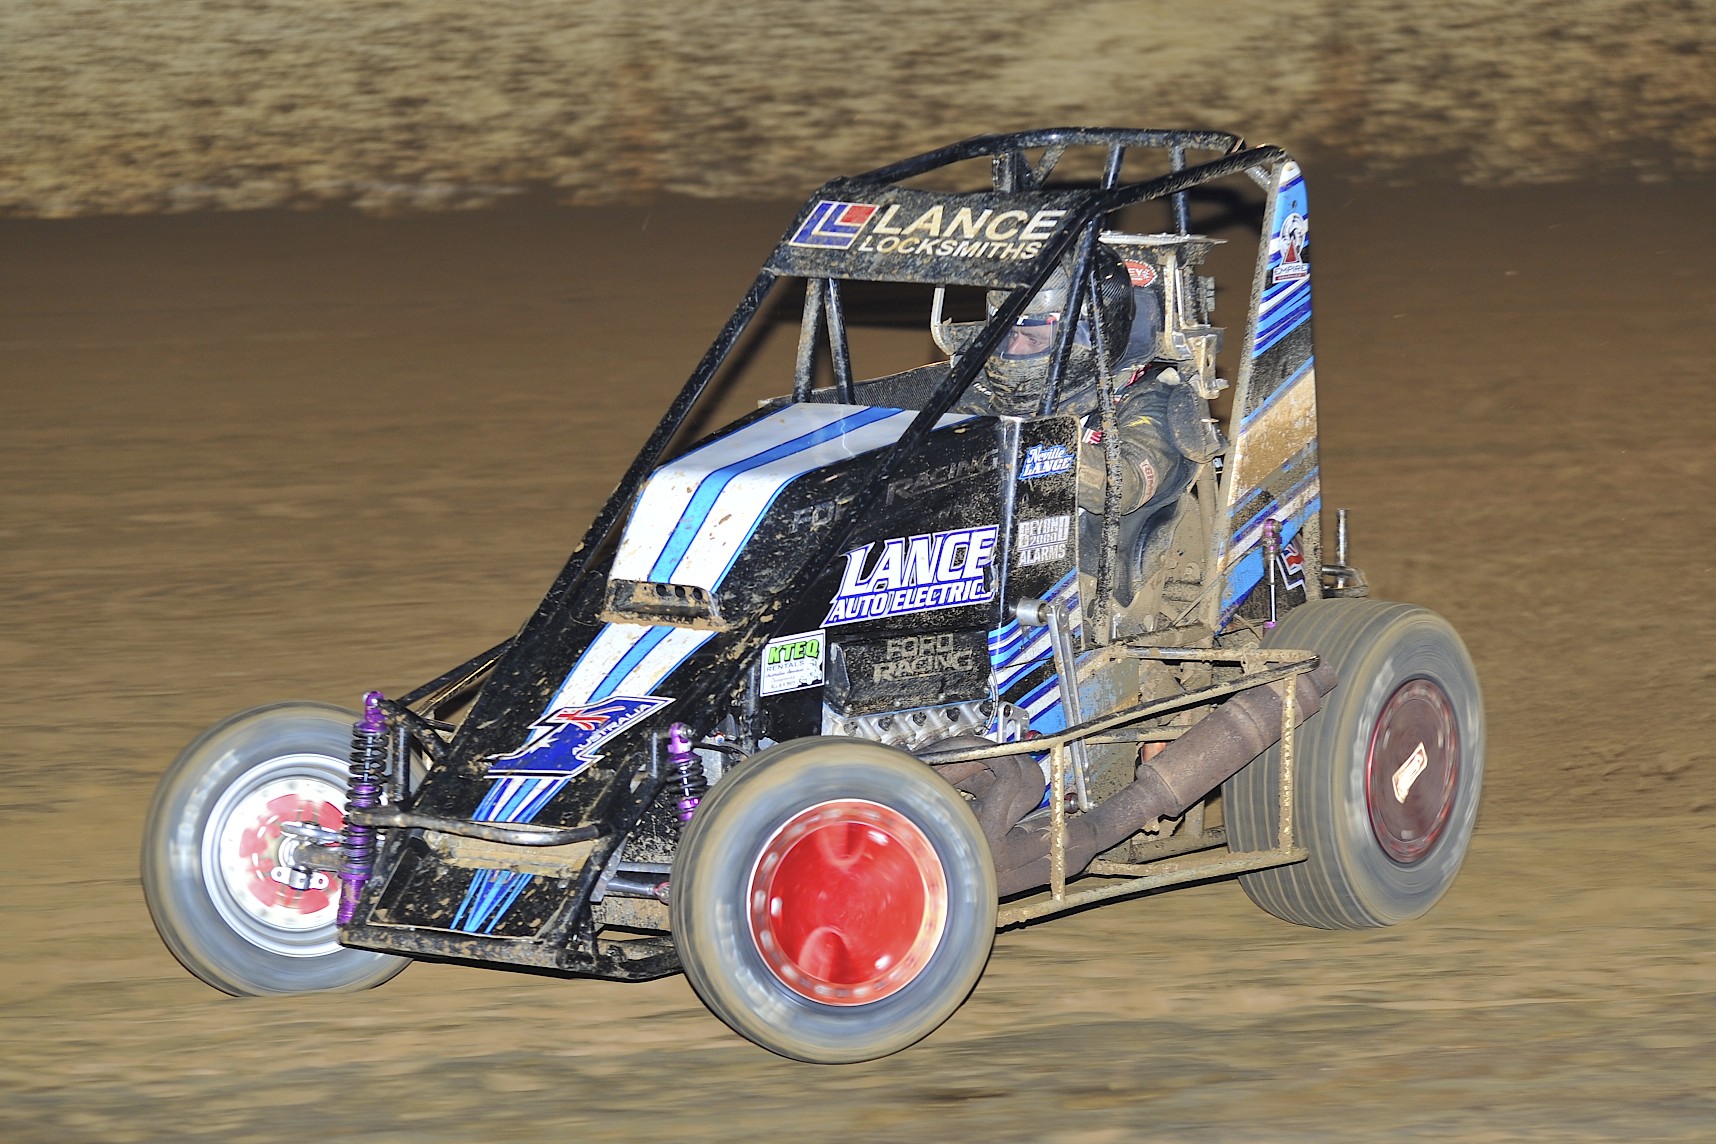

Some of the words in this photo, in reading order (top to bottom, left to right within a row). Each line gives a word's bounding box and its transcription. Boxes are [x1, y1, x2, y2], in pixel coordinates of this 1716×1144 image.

[871, 203, 1068, 241] LANCE
[857, 234, 1043, 261] LOCKSMITHS
[1022, 458, 1072, 477] LANCE
[1027, 446, 1066, 464] Neville
[836, 527, 998, 598] LANCE
[1018, 543, 1067, 567] ALARMS
[829, 590, 889, 623] AUTO
[891, 577, 995, 612] ELECTRIC
[768, 639, 819, 664] KTEQ
[887, 633, 954, 660] FORD
[767, 660, 804, 671] RENTALS
[873, 648, 974, 683] RACING
[572, 703, 651, 755] AUSTRALIA
